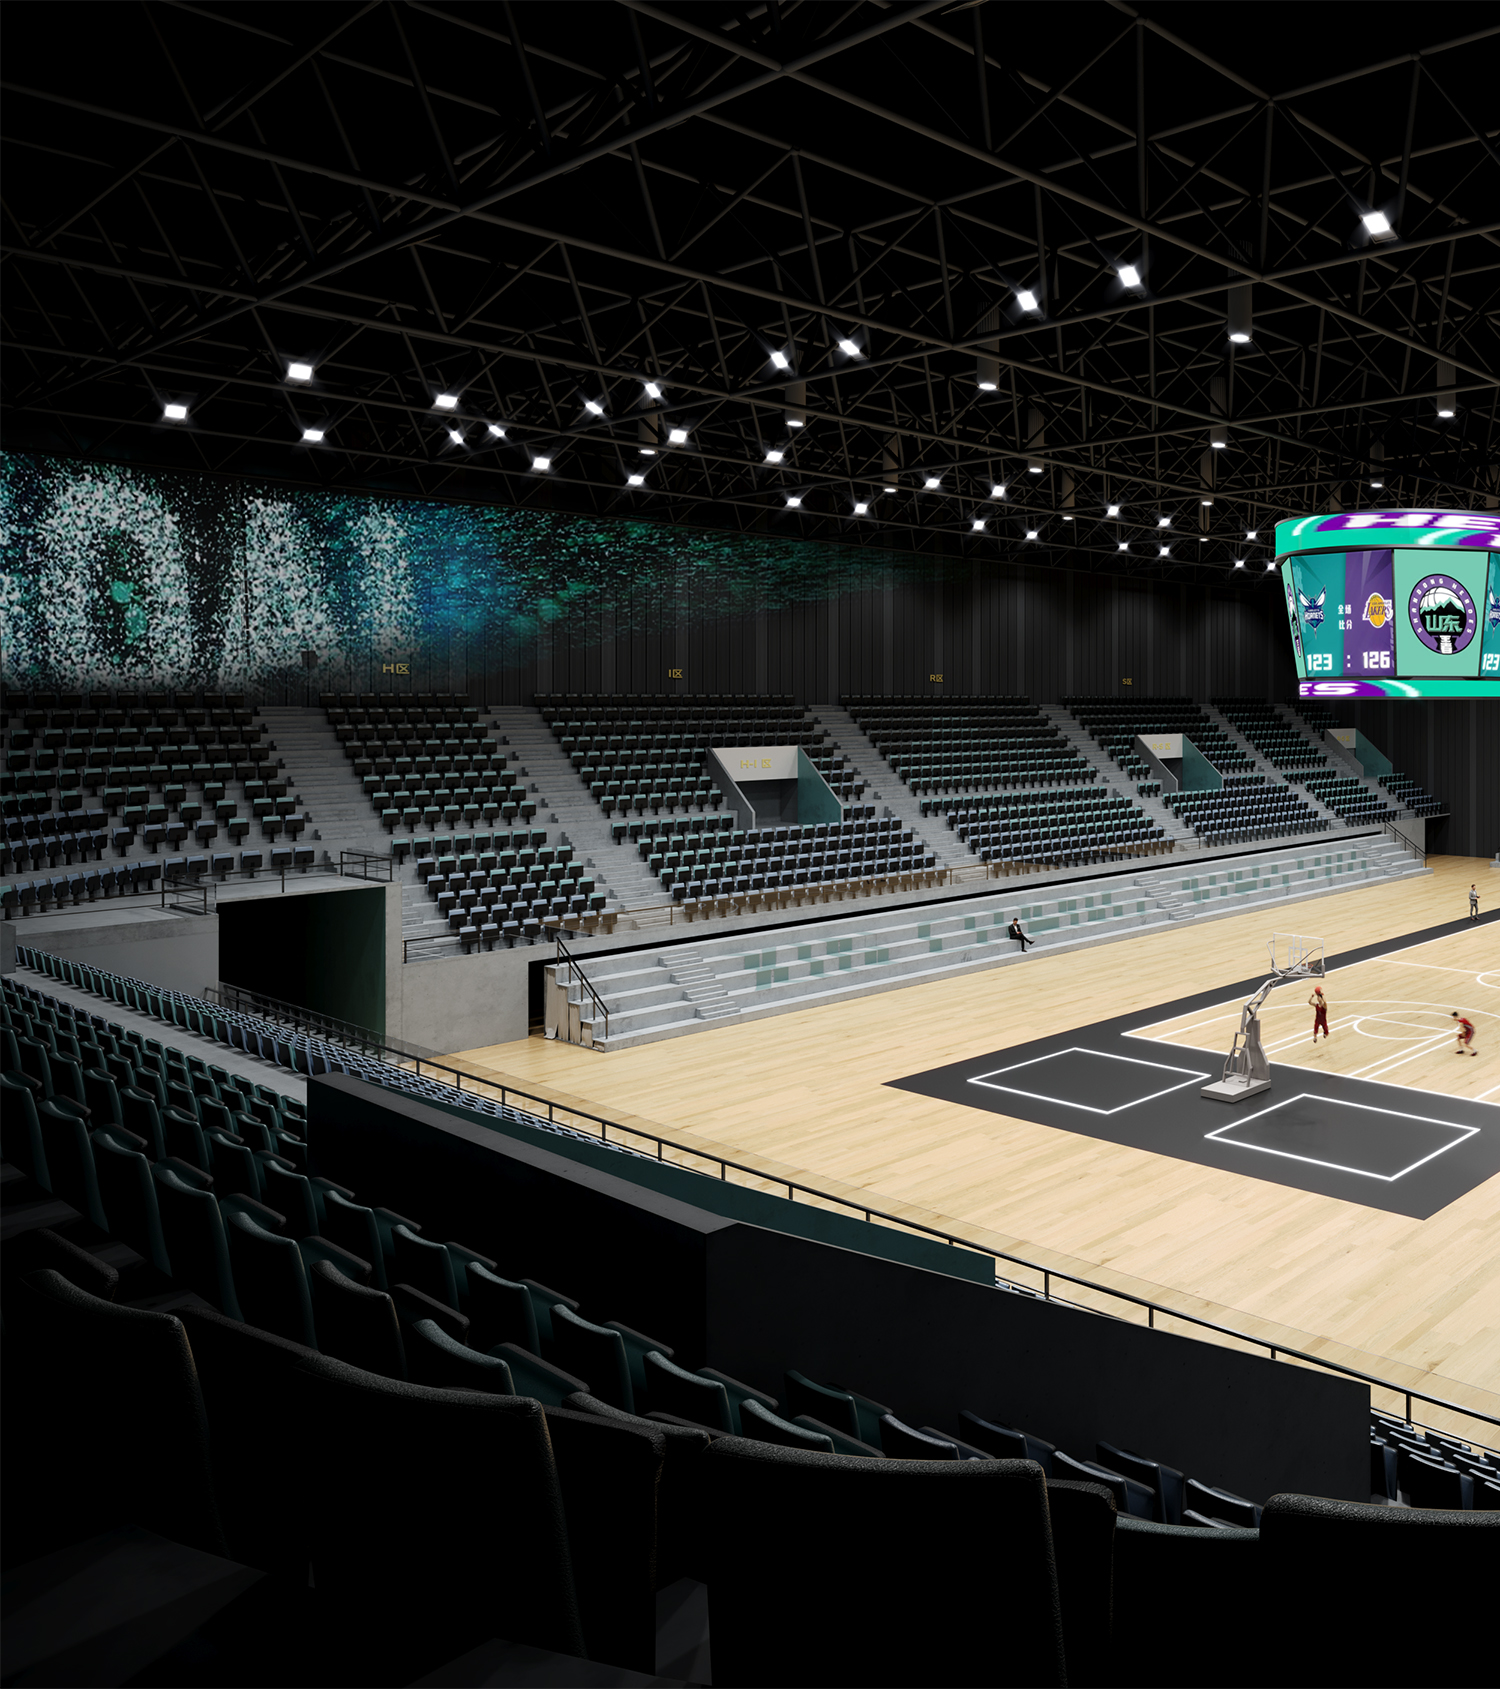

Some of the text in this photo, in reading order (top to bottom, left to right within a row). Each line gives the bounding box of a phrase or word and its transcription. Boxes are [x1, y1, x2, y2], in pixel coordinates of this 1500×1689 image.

[1307, 653, 1333, 671] 123
[1363, 651, 1391, 669] 126
[1482, 653, 1500, 671] 123
[382, 663, 410, 675] H区
[929, 674, 944, 683] R区
